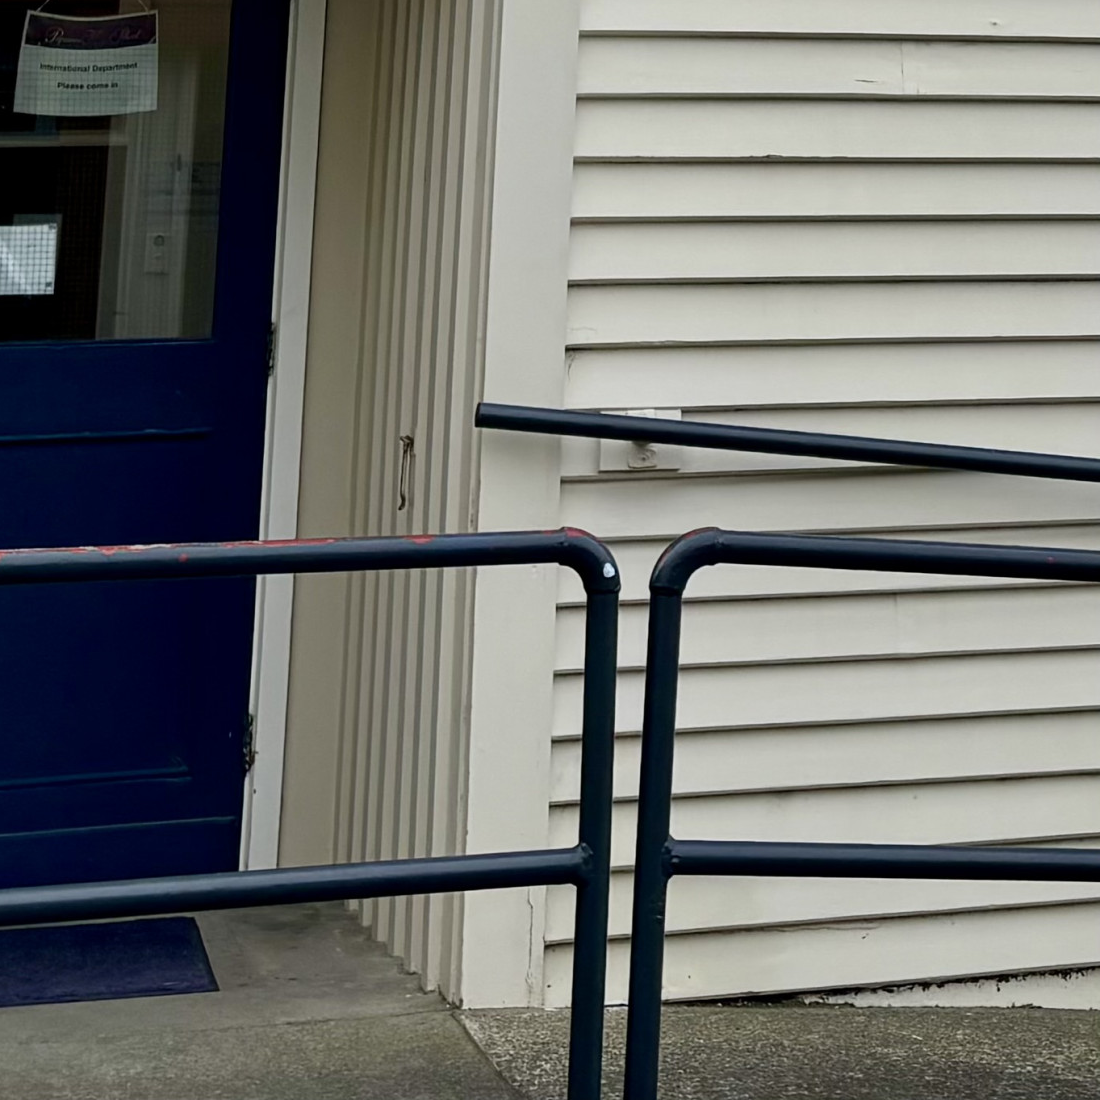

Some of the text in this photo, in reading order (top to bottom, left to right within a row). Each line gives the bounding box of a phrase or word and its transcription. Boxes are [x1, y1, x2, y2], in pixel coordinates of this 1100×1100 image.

[39, 62, 138, 73] International Department
[57, 82, 85, 90] Please
[86, 82, 109, 90] come
